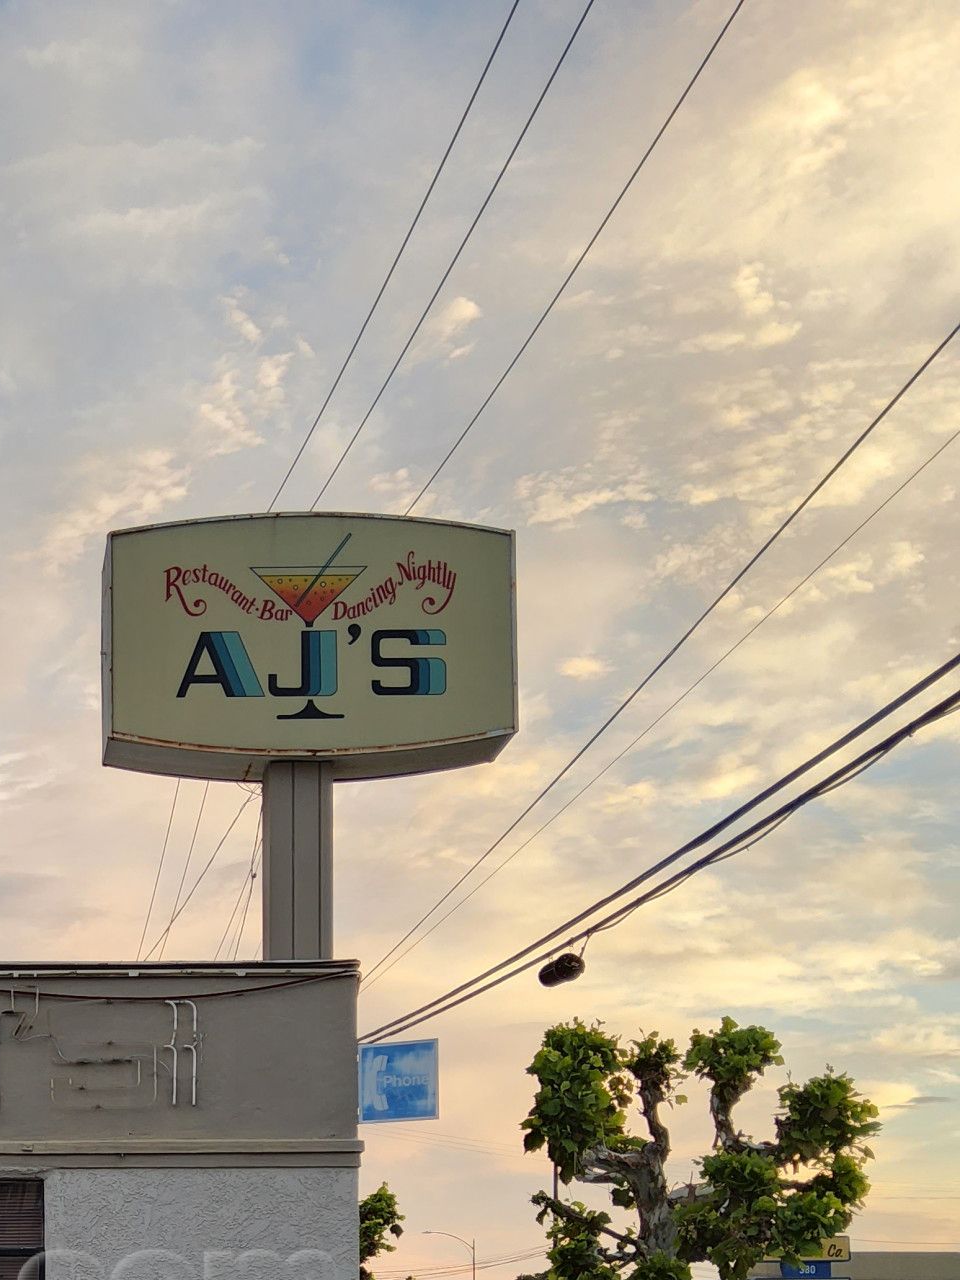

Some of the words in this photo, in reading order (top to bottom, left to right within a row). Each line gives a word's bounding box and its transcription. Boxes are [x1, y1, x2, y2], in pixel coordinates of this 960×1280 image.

[331, 577, 397, 621] Dancing
[396, 550, 457, 615] Nightly
[176, 623, 447, 699] AJ'S
[383, 1074, 429, 1088] Phone
